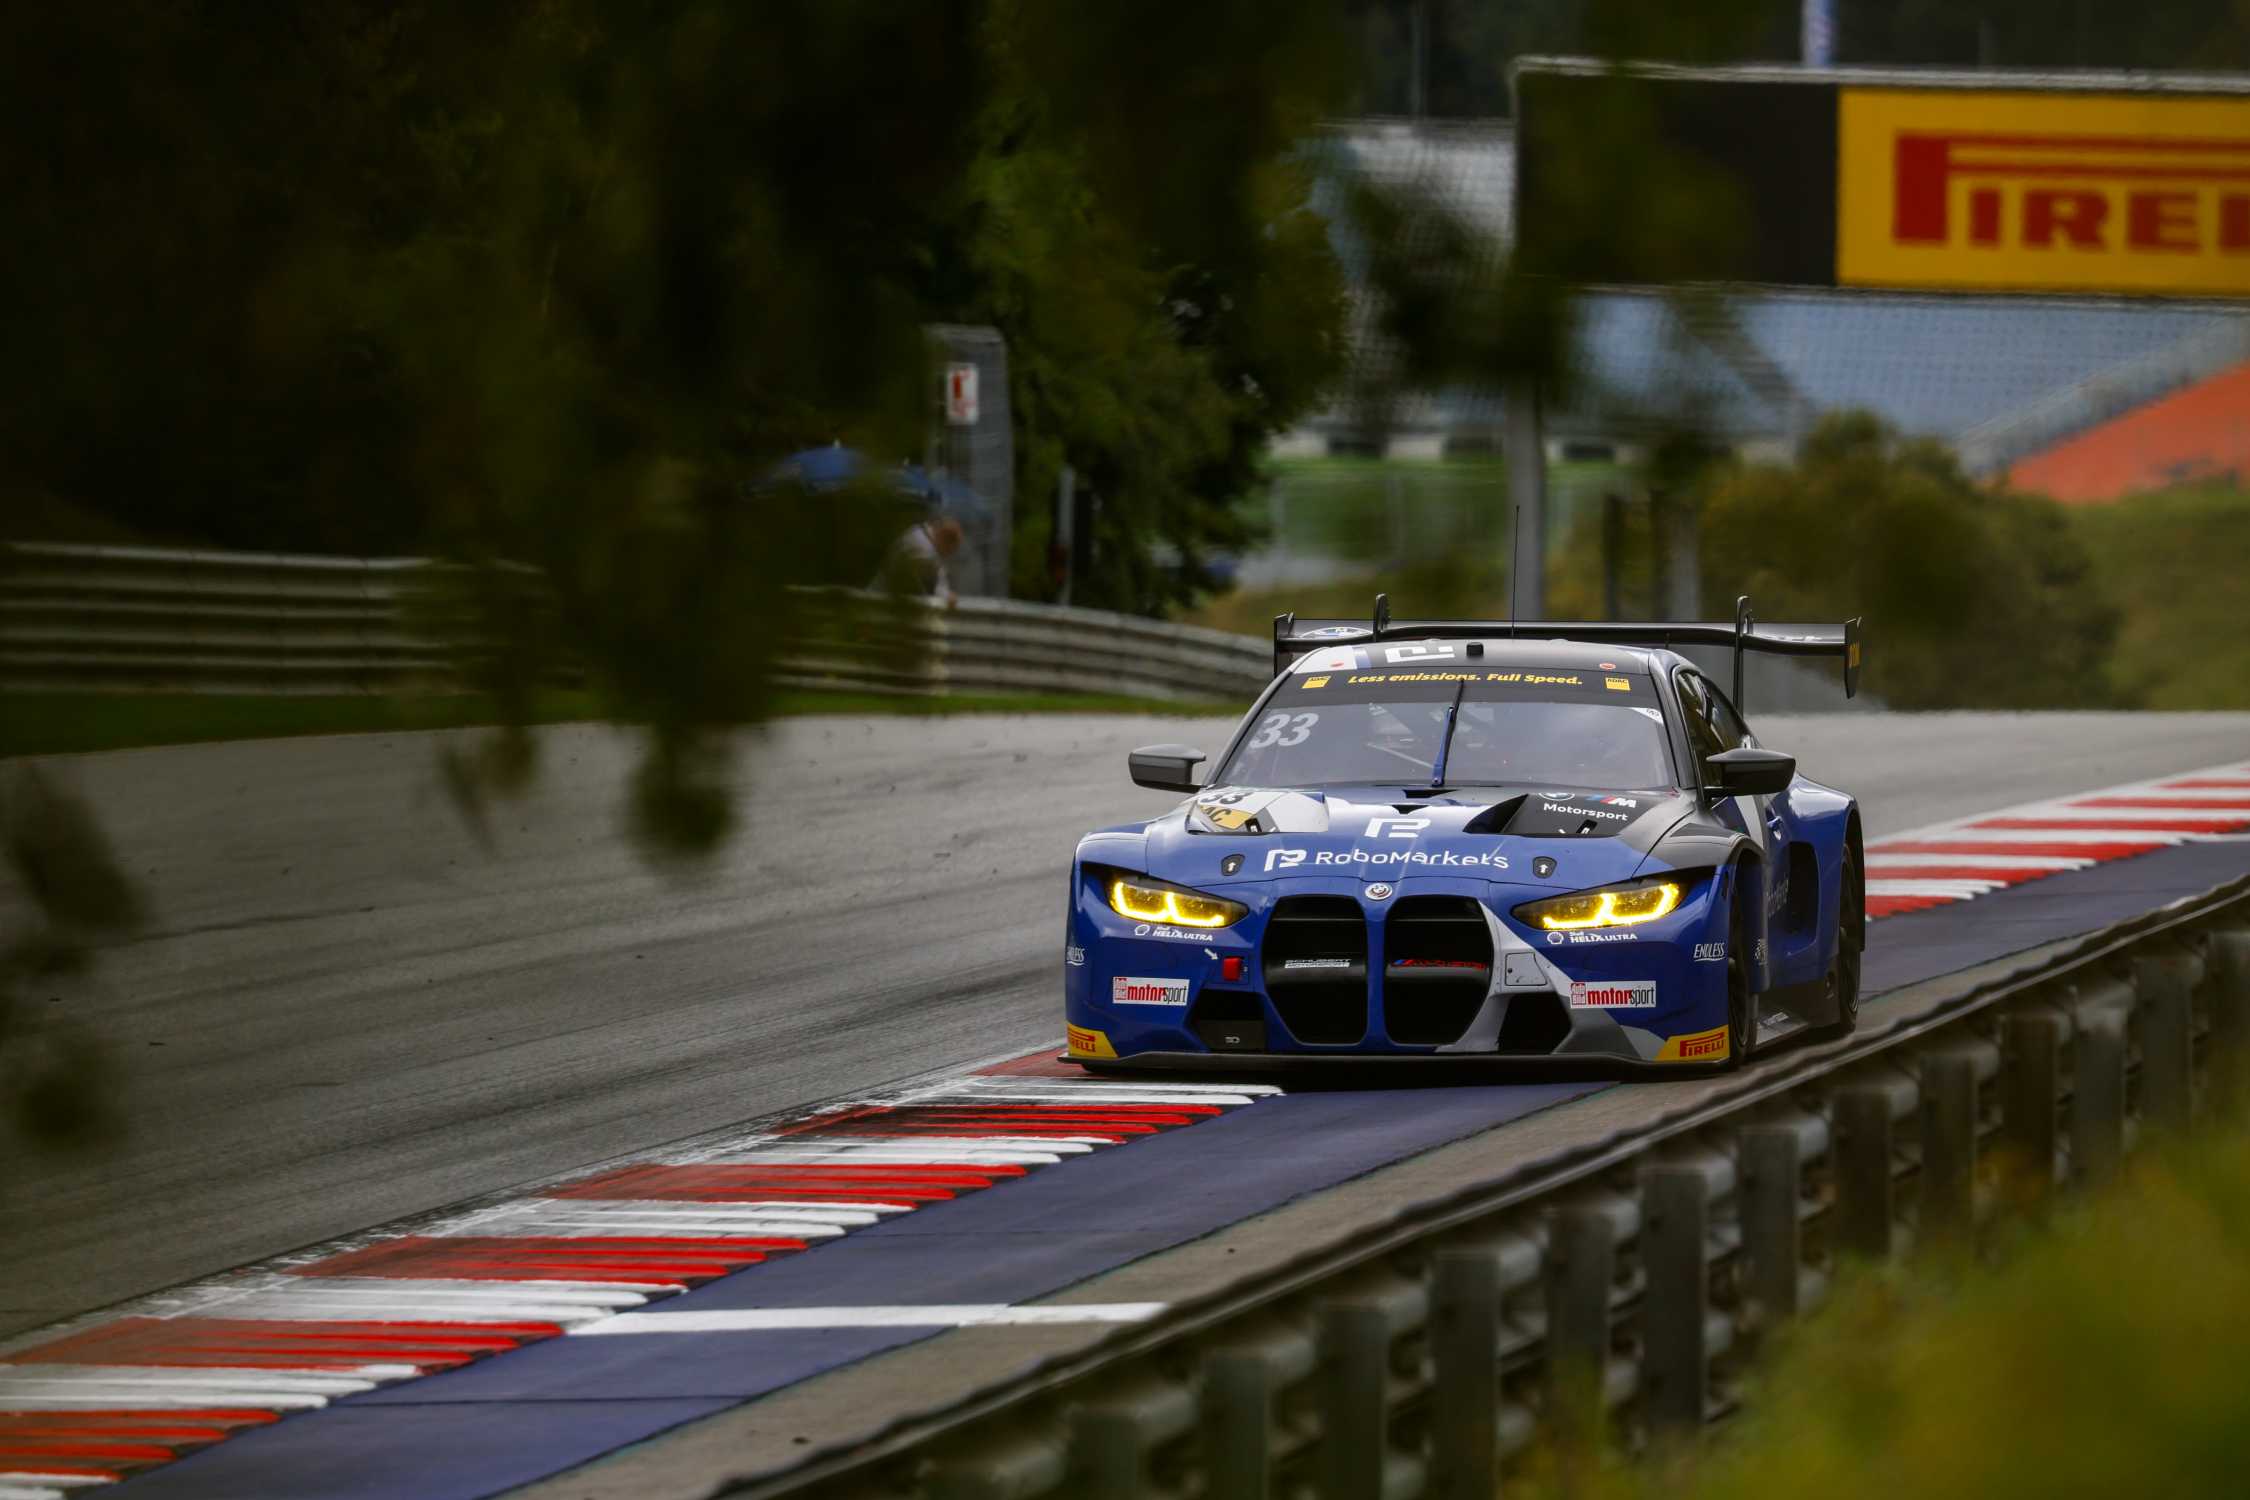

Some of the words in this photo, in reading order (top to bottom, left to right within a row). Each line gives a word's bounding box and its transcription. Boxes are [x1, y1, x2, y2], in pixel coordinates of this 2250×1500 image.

[1348, 674, 1385, 684] Less
[1389, 672, 1481, 682] emissions.
[1486, 673, 1522, 682] Full
[1523, 674, 1584, 686] Speed.
[1249, 712, 1319, 749] 33
[1543, 803, 1629, 821] Motorsport
[1315, 848, 1510, 869] RoboMarkets
[1693, 942, 1725, 959] ENDLESS
[1127, 984, 1188, 1005] motorsport
[1587, 986, 1655, 1007] motorsport
[1679, 1031, 1725, 1058] PIRELLI
